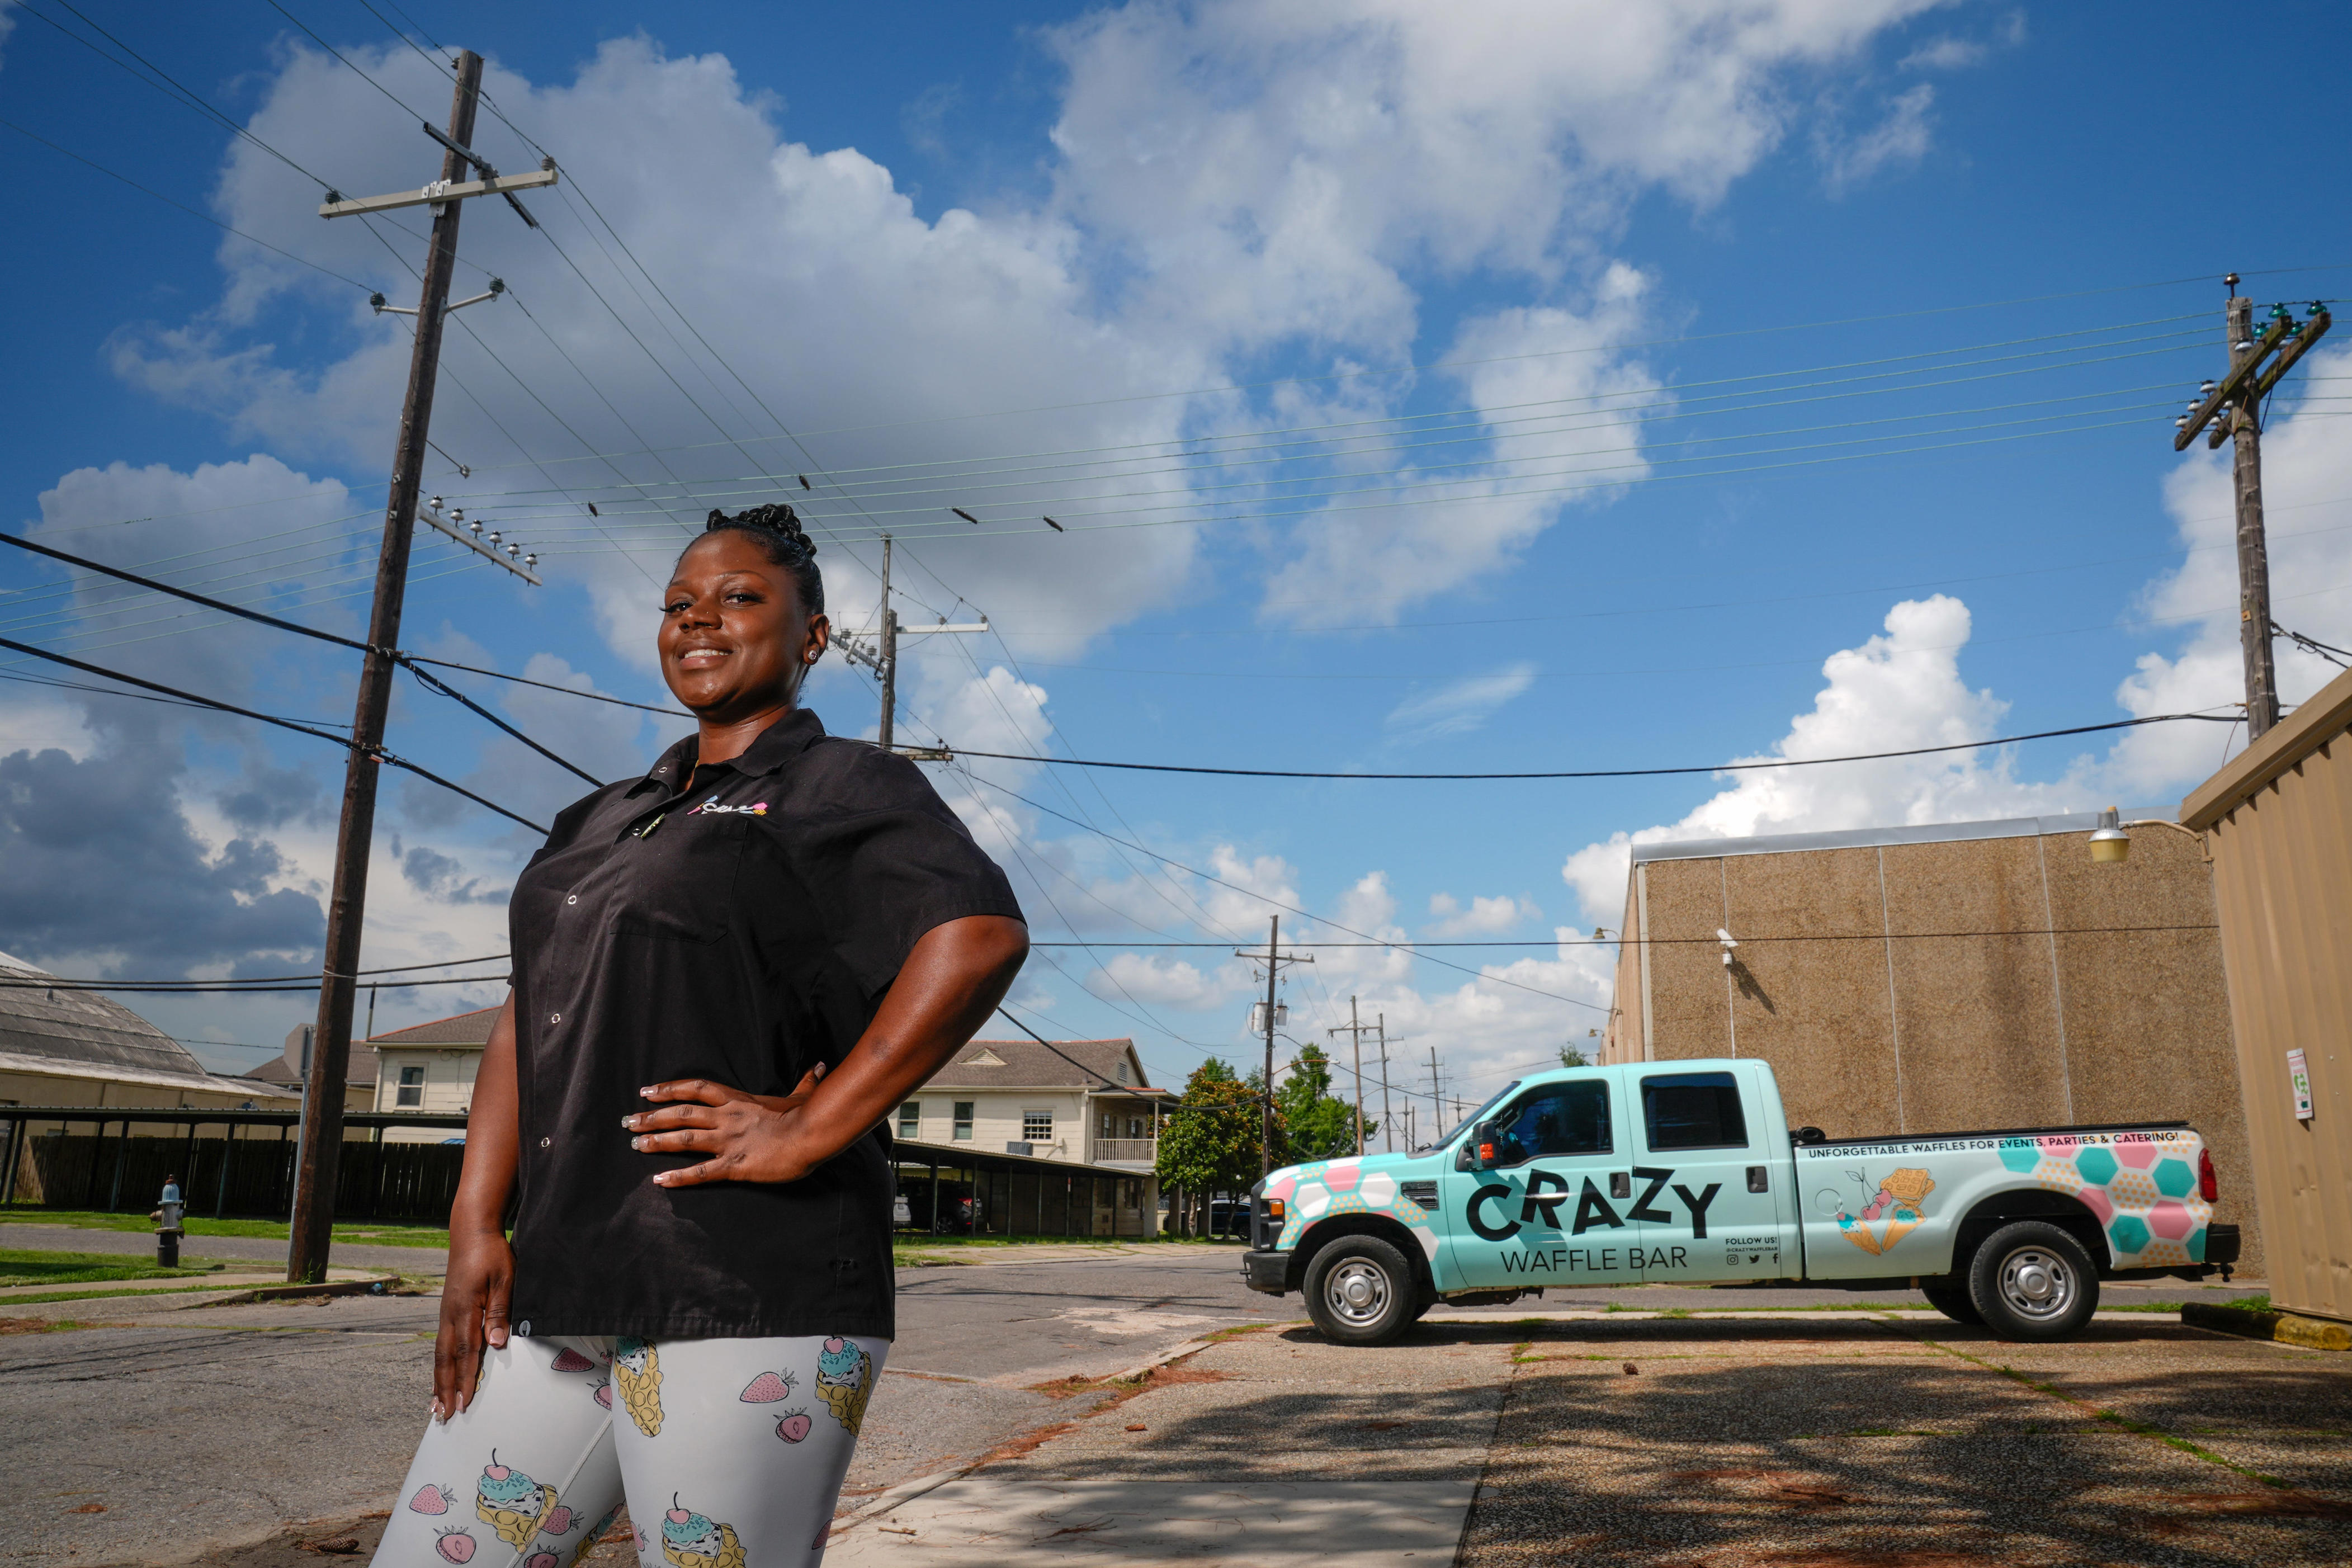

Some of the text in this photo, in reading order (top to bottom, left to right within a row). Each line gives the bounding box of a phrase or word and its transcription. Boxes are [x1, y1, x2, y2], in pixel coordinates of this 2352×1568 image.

[1808, 1131, 2179, 1158] UNFORGETTABLE WAFFLES FOR EVENTS, PARTIES & CATERING!
[1466, 1166, 1722, 1241] CRAZY
[1500, 1246, 1688, 1273] WAFFLE BAR
